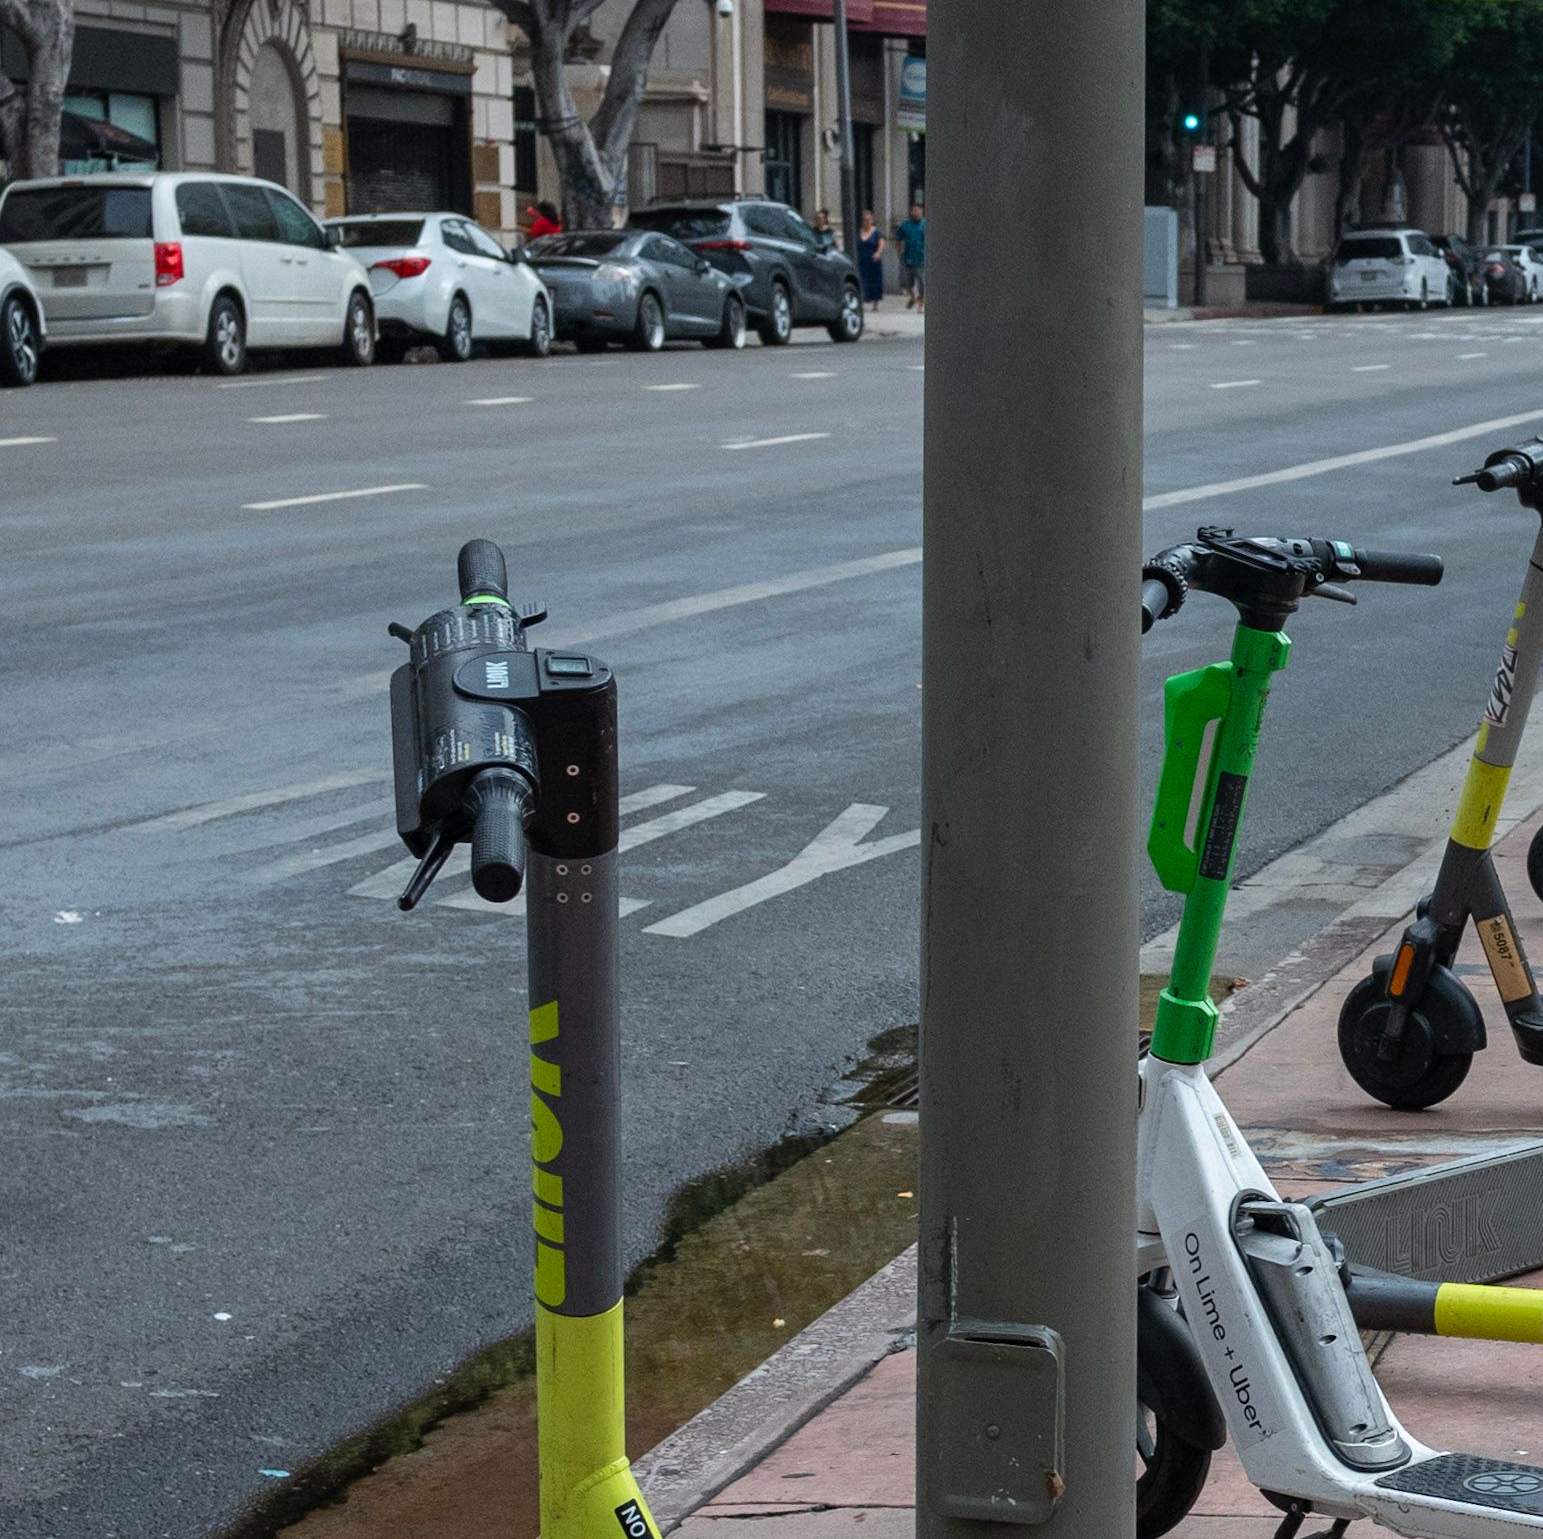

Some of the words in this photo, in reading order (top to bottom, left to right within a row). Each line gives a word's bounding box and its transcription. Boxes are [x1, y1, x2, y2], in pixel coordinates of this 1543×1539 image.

[486, 661, 509, 688] LINK
[1185, 1232, 1203, 1274] On
[1196, 1276, 1226, 1341] Lime
[1224, 1346, 1235, 1361] +
[1229, 1364, 1263, 1429] Uber
[622, 1505, 647, 1538] NO
